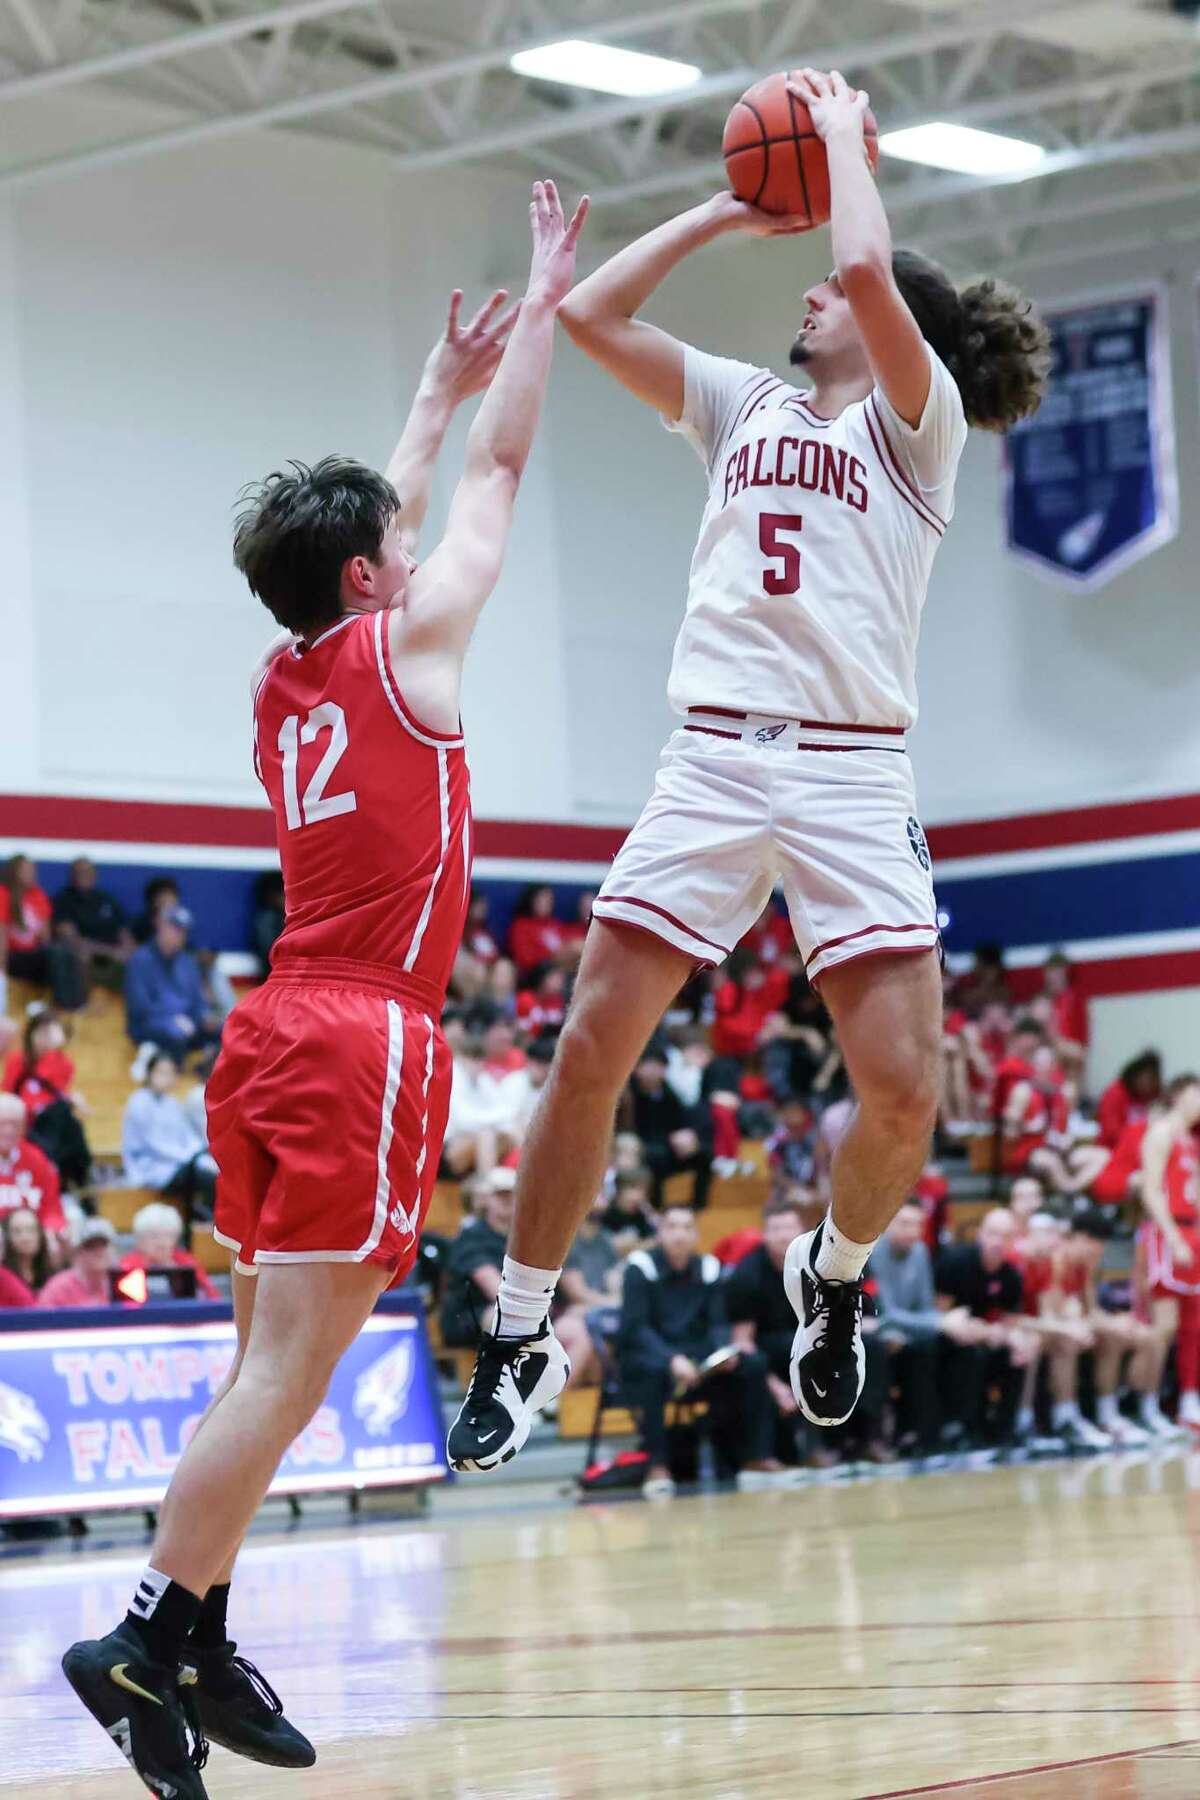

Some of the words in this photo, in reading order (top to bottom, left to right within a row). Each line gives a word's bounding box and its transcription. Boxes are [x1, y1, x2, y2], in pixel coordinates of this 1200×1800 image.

[721, 436, 868, 513] FALCONS
[759, 512, 802, 596] 5
[277, 701, 357, 831] 12
